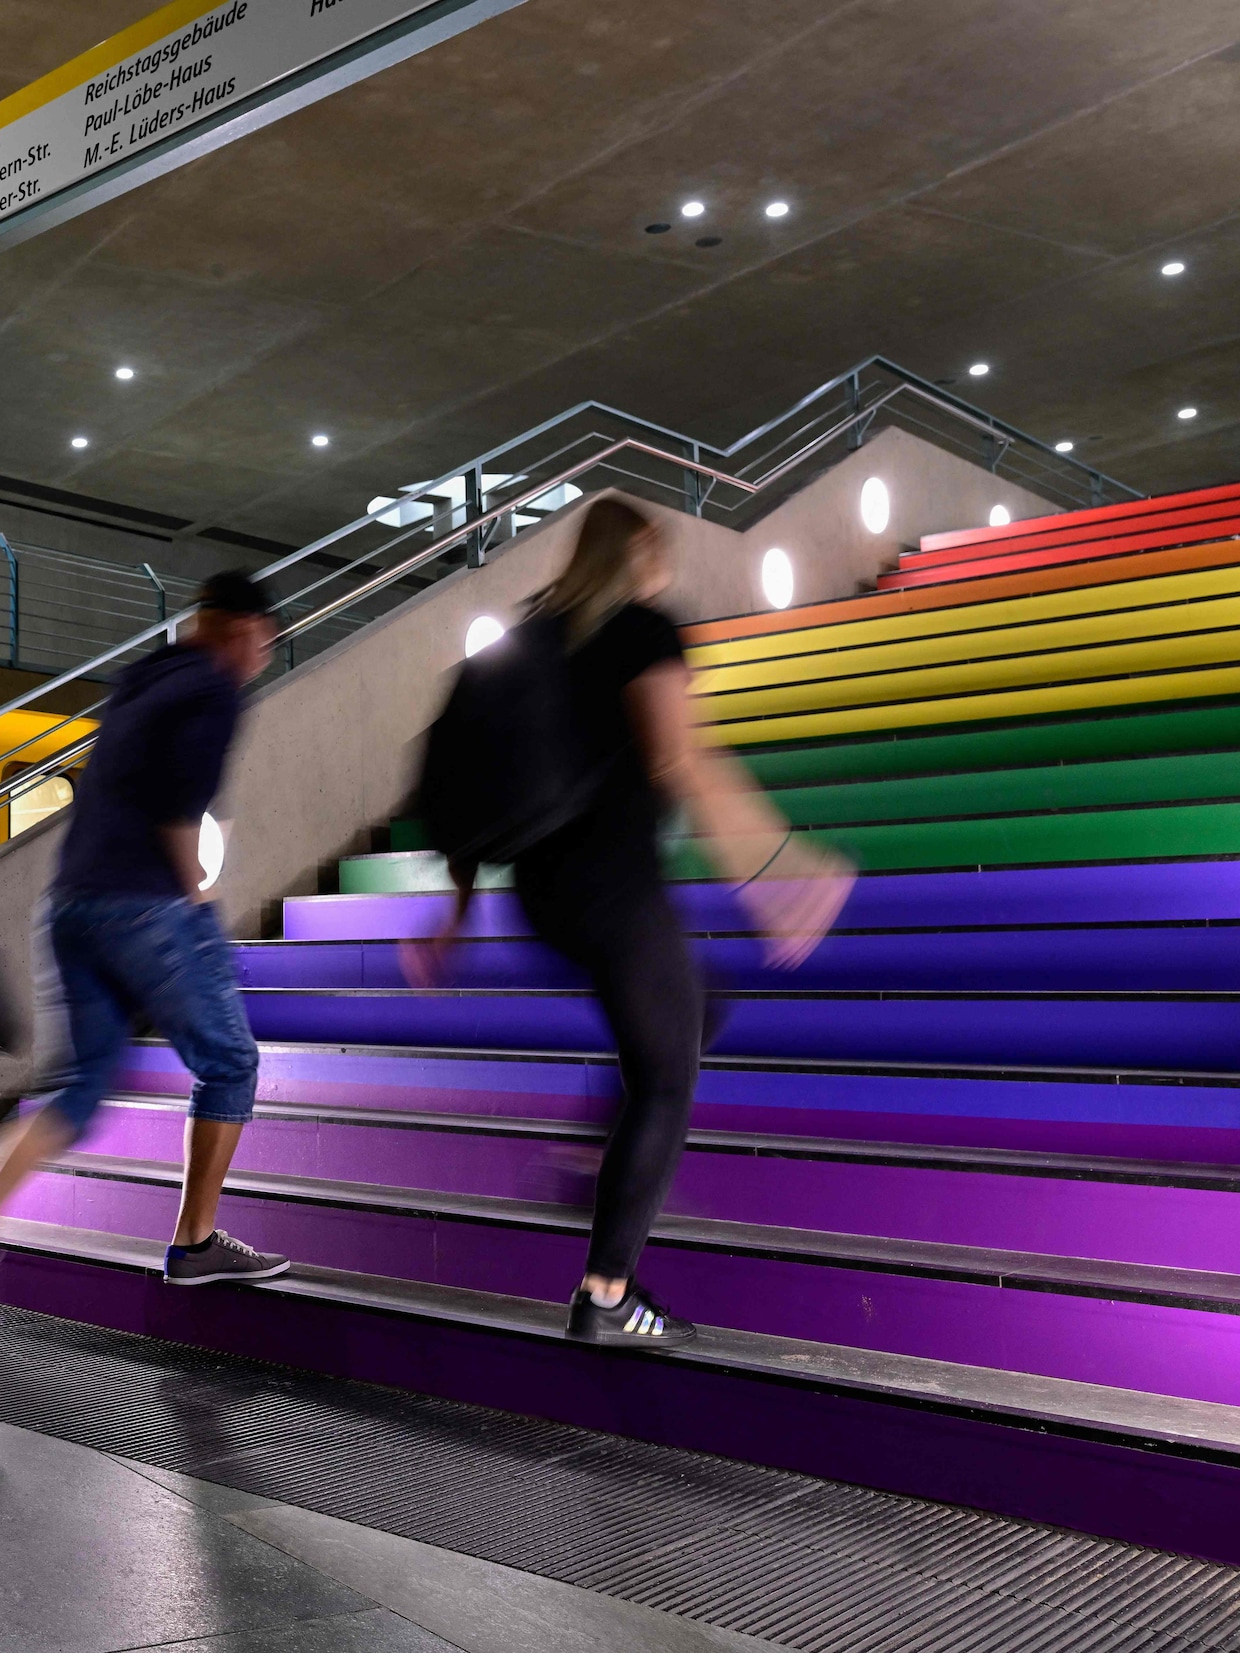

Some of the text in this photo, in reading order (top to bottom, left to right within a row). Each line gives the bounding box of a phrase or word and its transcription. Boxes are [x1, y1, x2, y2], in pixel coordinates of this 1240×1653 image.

[310, 0, 343, 17] Ha
[84, 0, 248, 106] Reichstagsgebäude
[84, 54, 213, 137] Paul-Löbe-Haus
[83, 76, 236, 169] M.-E. Lüders-Haus
